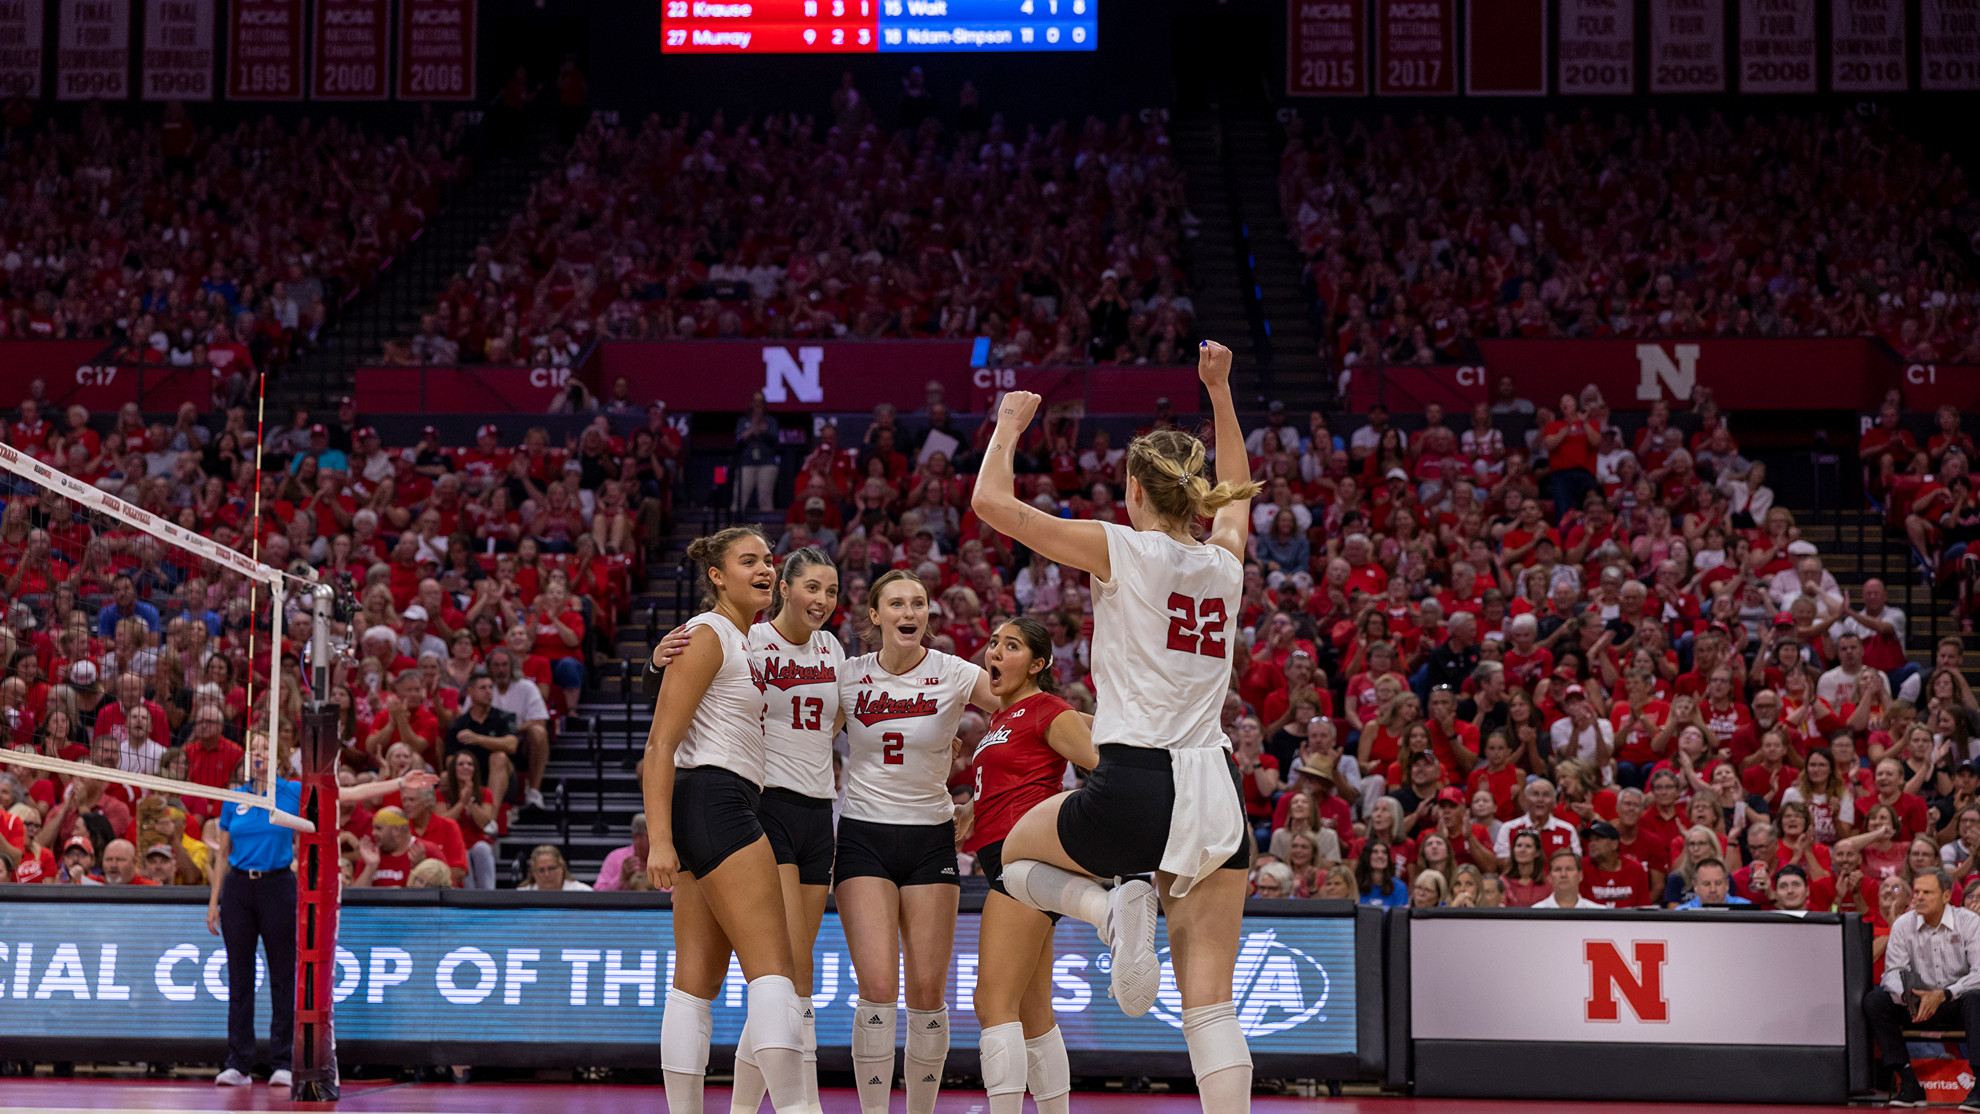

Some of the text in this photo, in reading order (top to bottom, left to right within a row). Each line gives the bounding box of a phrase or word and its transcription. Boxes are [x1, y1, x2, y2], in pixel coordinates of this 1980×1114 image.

[239, 10, 289, 25] NCAA
[324, 10, 375, 25] NCAA
[410, 10, 462, 25] NCAA
[667, 1, 688, 18] 22
[693, 1, 752, 18] Krause
[832, 1, 845, 17] 3
[861, 1, 869, 17] 1
[1020, 0, 1034, 15] 4
[1049, 0, 1057, 15] 1
[1300, 4, 1352, 19] NCAA
[1388, 4, 1440, 19] NCAA
[667, 28, 870, 49] 27 Murray 9 2 3
[1046, 27, 1060, 44] 0
[1072, 27, 1086, 44] 0
[238, 64, 290, 92] 1995
[323, 64, 376, 92] 2000
[409, 64, 463, 92] 2006
[1300, 59, 1355, 87] 2015
[1388, 59, 1441, 87] 2017
[1566, 65, 1628, 84] 2001
[1657, 65, 1718, 84] 2005
[1747, 62, 1809, 81] 2008
[1839, 61, 1900, 81] 2016
[67, 72, 120, 92] 1996
[151, 72, 205, 92] 1998
[76, 366, 118, 386] C17
[762, 345, 824, 402] N
[973, 369, 1016, 389] C18
[1456, 366, 1486, 386] C1
[1636, 343, 1701, 401] N
[1906, 364, 1936, 385] C1
[1166, 591, 1228, 659] 22
[764, 656, 836, 682] Nebraska
[854, 689, 939, 715] Nebraska
[791, 695, 824, 730] 13
[882, 732, 904, 764] 2
[0, 942, 131, 1000] IAL
[435, 946, 541, 1005] OF
[561, 948, 676, 1006] TH
[1582, 938, 1669, 1023] N
[1919, 1080, 1958, 1090] meritas
